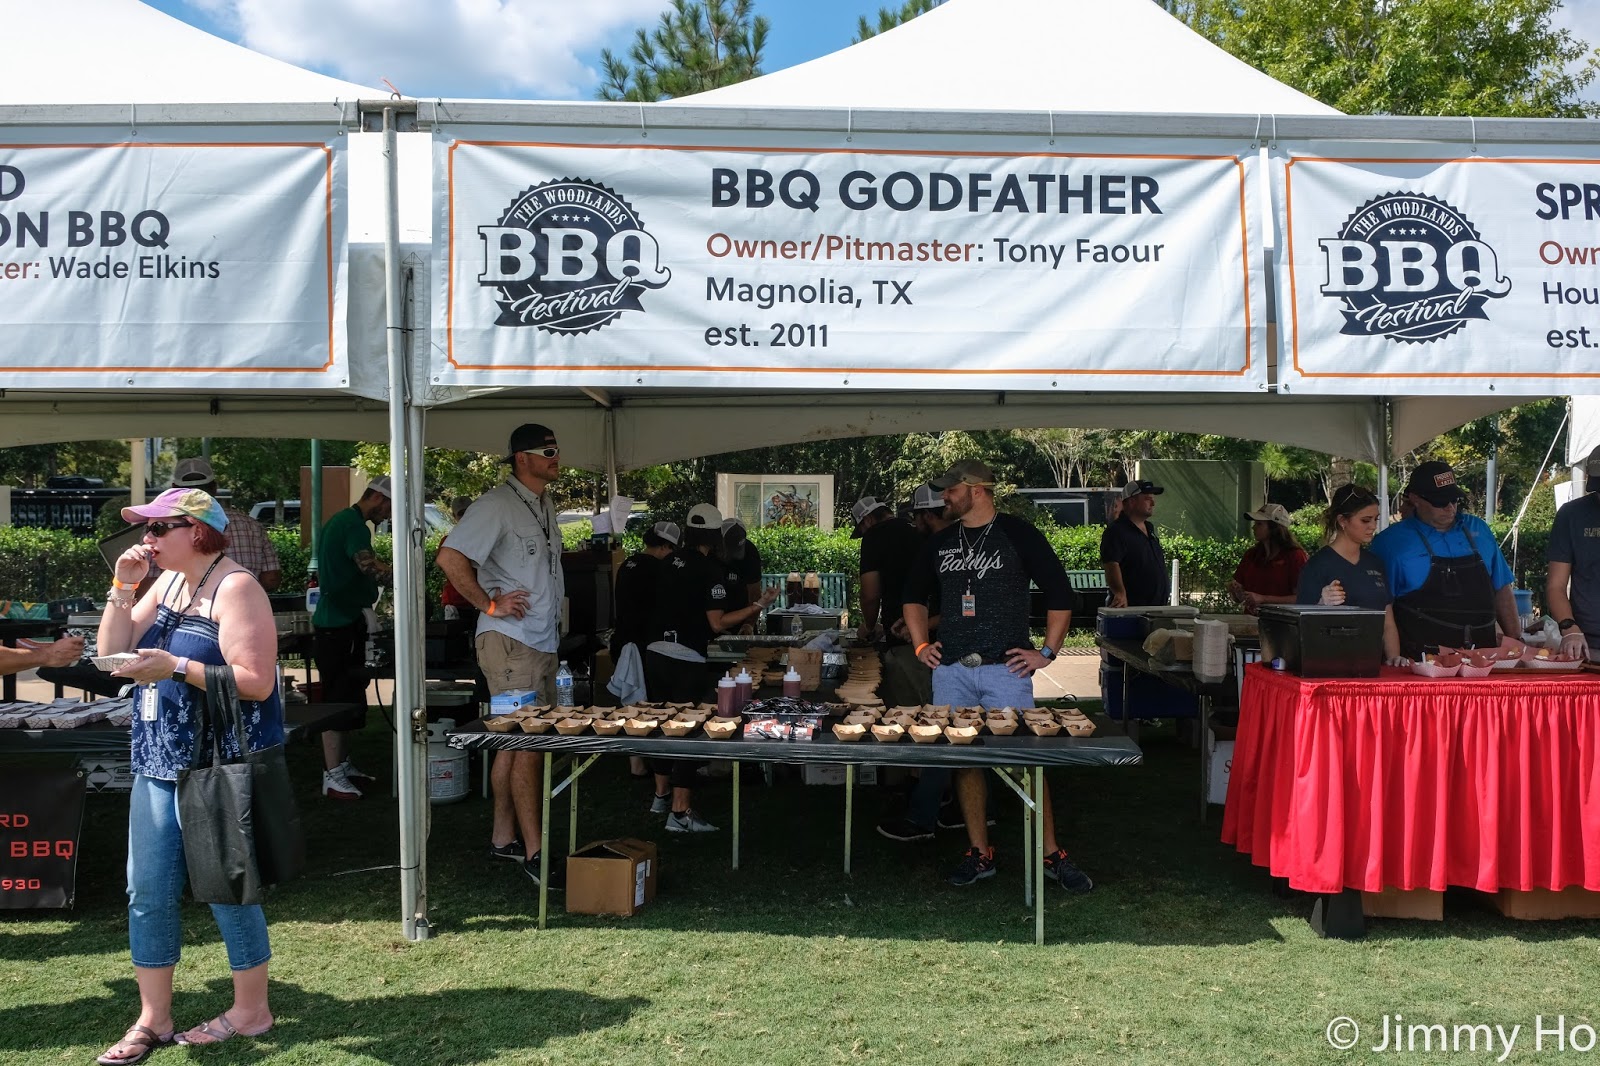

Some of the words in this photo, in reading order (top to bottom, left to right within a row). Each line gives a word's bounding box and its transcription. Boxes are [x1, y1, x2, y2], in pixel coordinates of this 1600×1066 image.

[513, 195, 543, 224] THE
[543, 188, 628, 225] WOODLANDS
[711, 168, 821, 213] BBQ
[838, 170, 1164, 215] GODFATHER
[1535, 182, 1600, 220] SPR
[67, 210, 171, 250] BBQ
[1352, 210, 1380, 236] THE
[1378, 201, 1464, 237] WOODLANDS
[49, 255, 129, 279] Wade
[139, 255, 220, 279] Elkins
[478, 225, 672, 289] BBQ
[706, 232, 984, 263] Owner/Pitmaster:
[993, 237, 1066, 270] Tony
[1076, 238, 1165, 263] Faour
[1318, 237, 1512, 298] BBQ
[1539, 240, 1600, 265] Own
[510, 276, 633, 323] Festival
[705, 276, 862, 309] Magnolia,
[872, 280, 914, 306] TX
[1355, 286, 1475, 332] Festival
[1542, 281, 1599, 305] Hou
[704, 323, 760, 347] est.
[770, 323, 828, 348] 2011
[1546, 326, 1599, 348] est.
[938, 548, 963, 556] DEACON
[0, 814, 29, 828] RD
[10, 840, 74, 860] BBQ
[1, 879, 41, 890] 930
